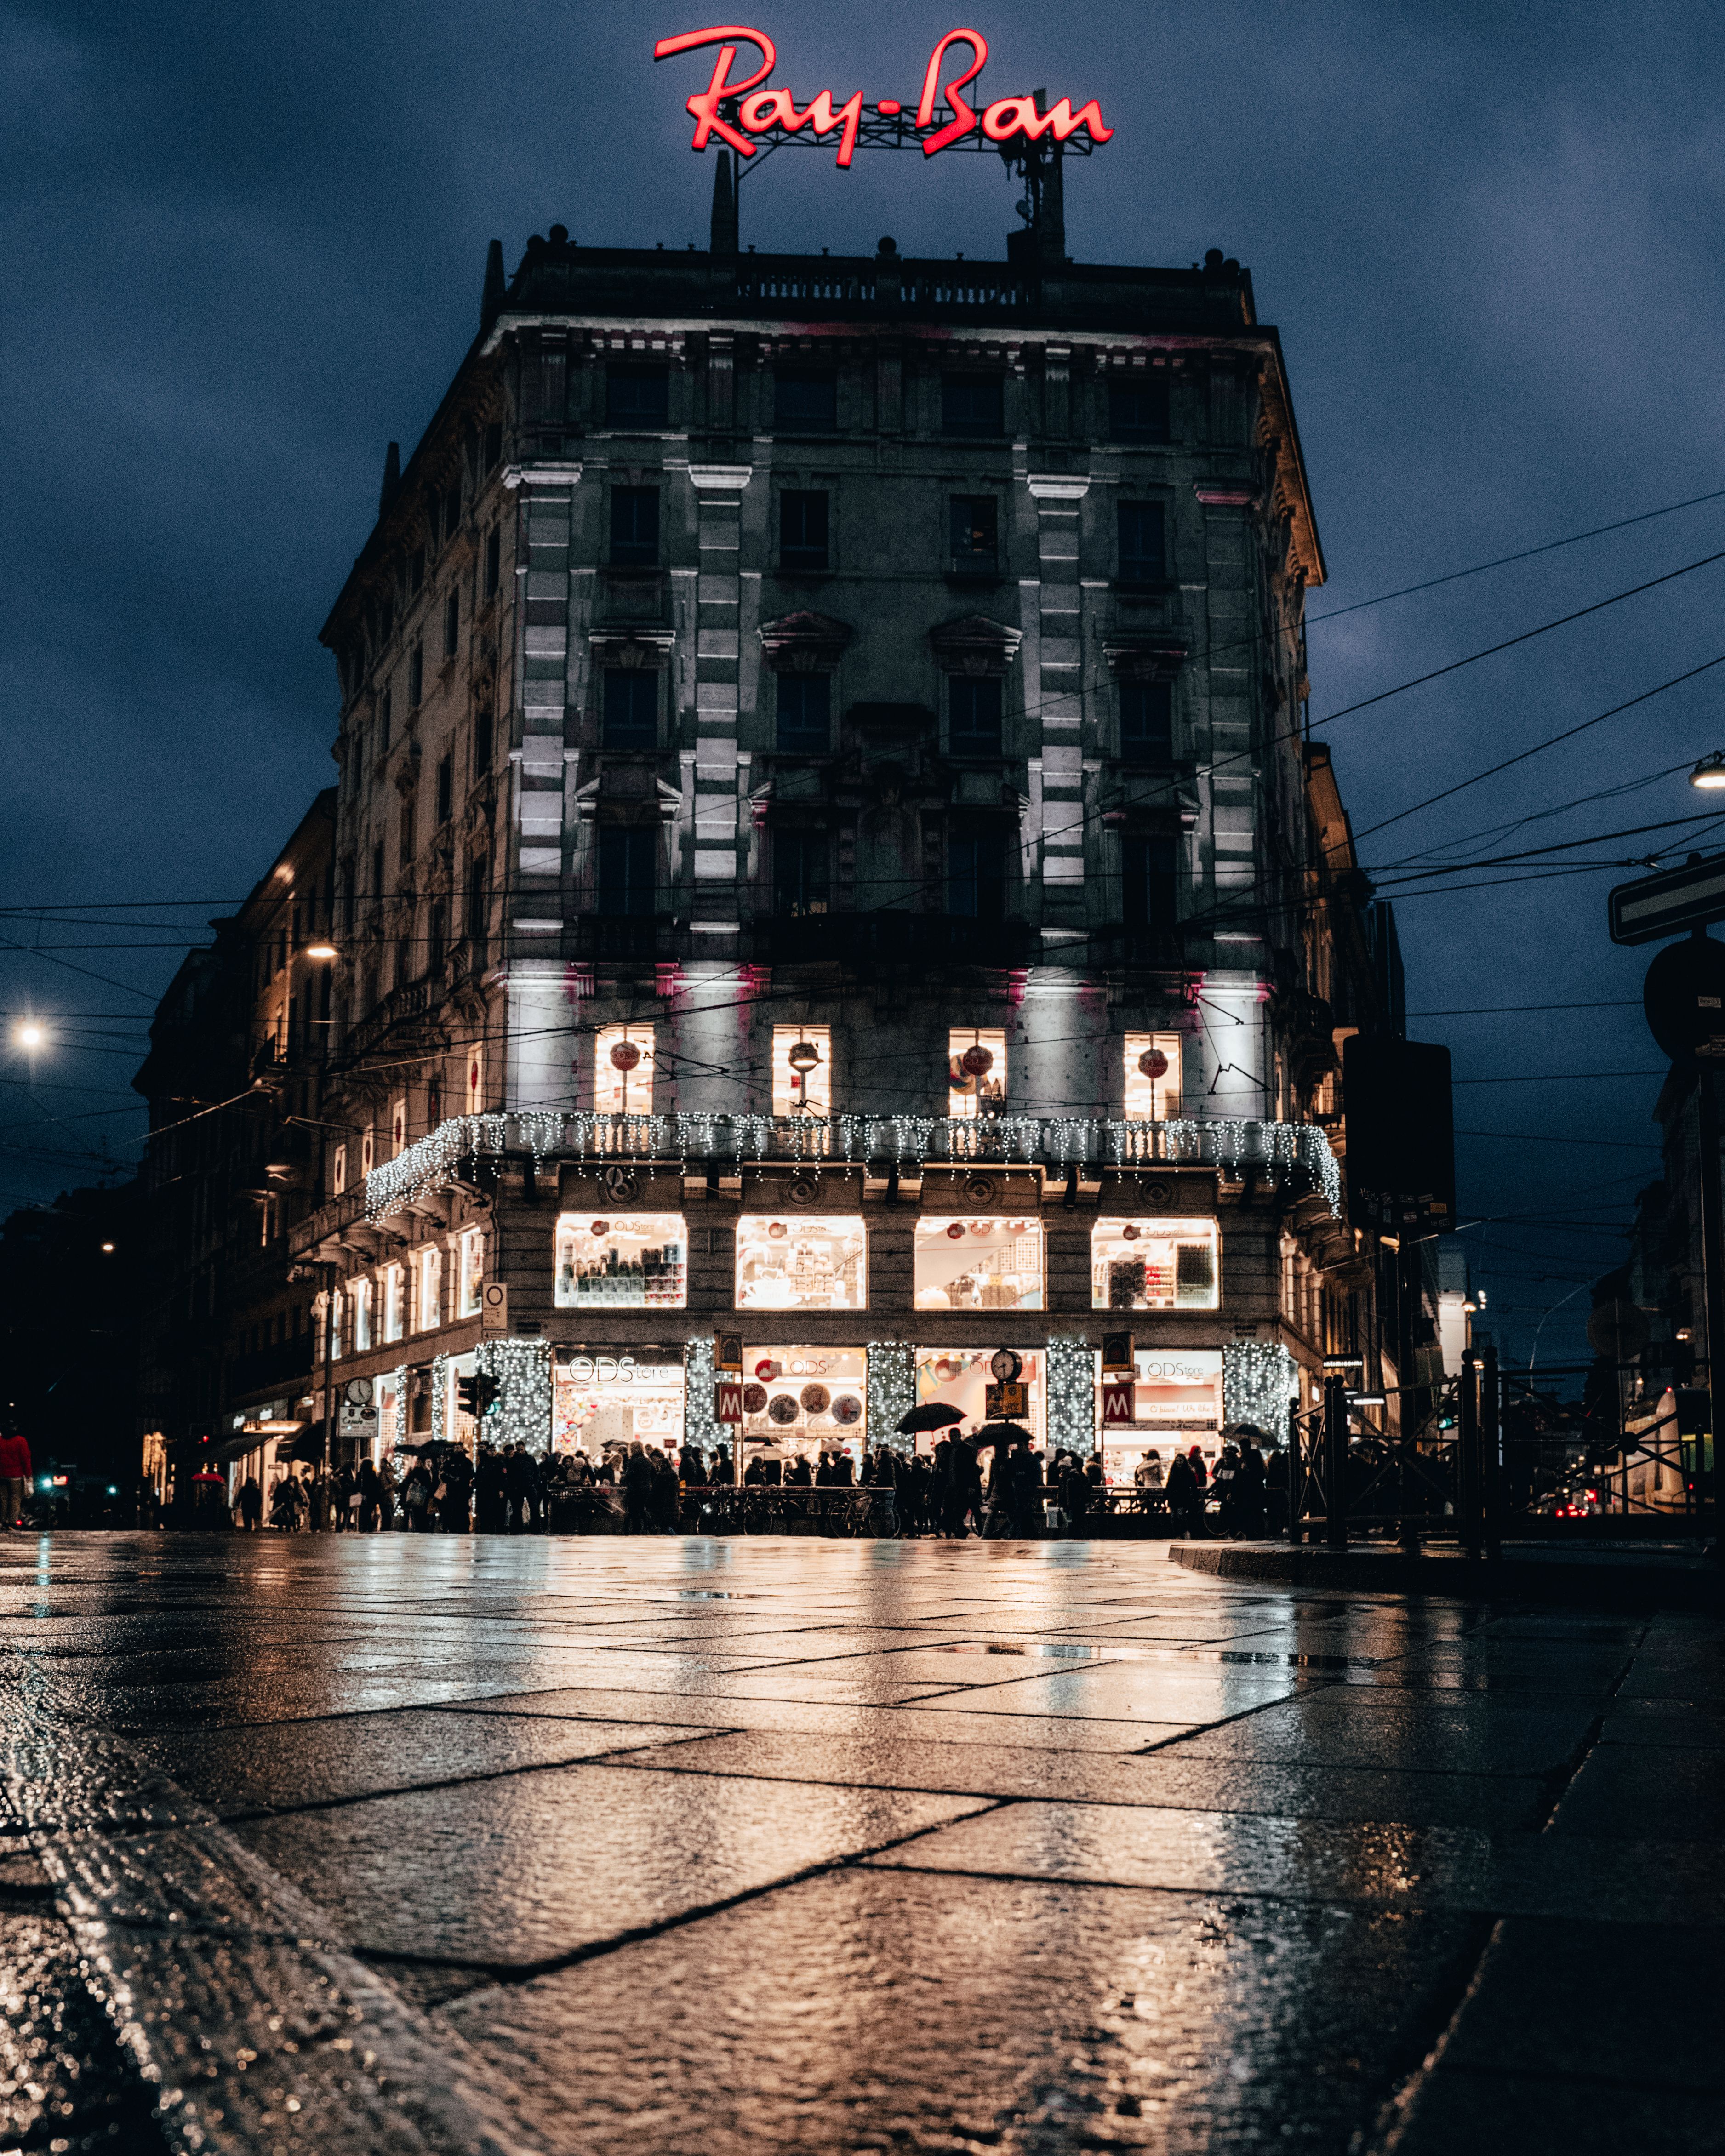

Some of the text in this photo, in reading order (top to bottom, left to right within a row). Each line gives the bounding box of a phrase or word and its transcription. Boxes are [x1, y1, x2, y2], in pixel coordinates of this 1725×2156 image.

[654, 25, 1114, 167] Ray-Ban
[569, 1357, 669, 1383] ODStore
[790, 1360, 847, 1375] ODStore
[1148, 1363, 1204, 1376] ODStore
[721, 1392, 741, 1415] M
[1105, 1393, 1130, 1415] M
